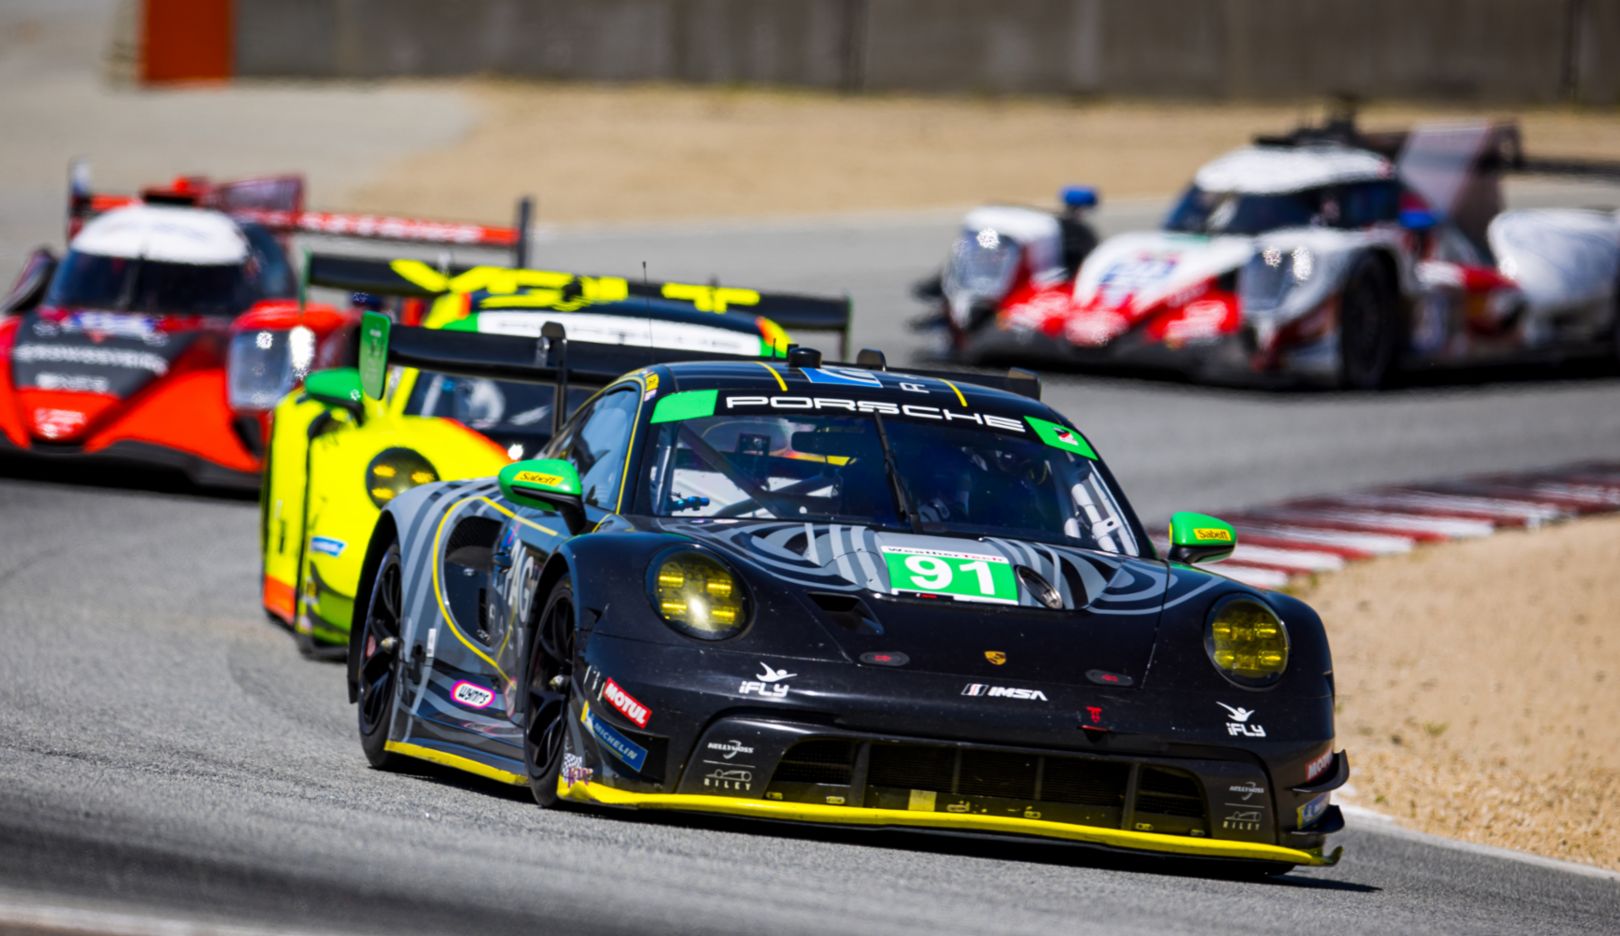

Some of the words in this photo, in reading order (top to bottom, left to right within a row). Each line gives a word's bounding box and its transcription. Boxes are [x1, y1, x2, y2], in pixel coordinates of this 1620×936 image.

[726, 396, 1026, 432] PORSCHE
[519, 473, 556, 485] Sabelt
[1197, 528, 1230, 540] Sabelt
[904, 555, 996, 595] 91
[987, 686, 1049, 701] IMSA
[604, 682, 647, 725] MOTUL
[594, 722, 638, 760] MICHELIN
[704, 778, 752, 791] RILEY
[1223, 820, 1260, 831] RILEY
